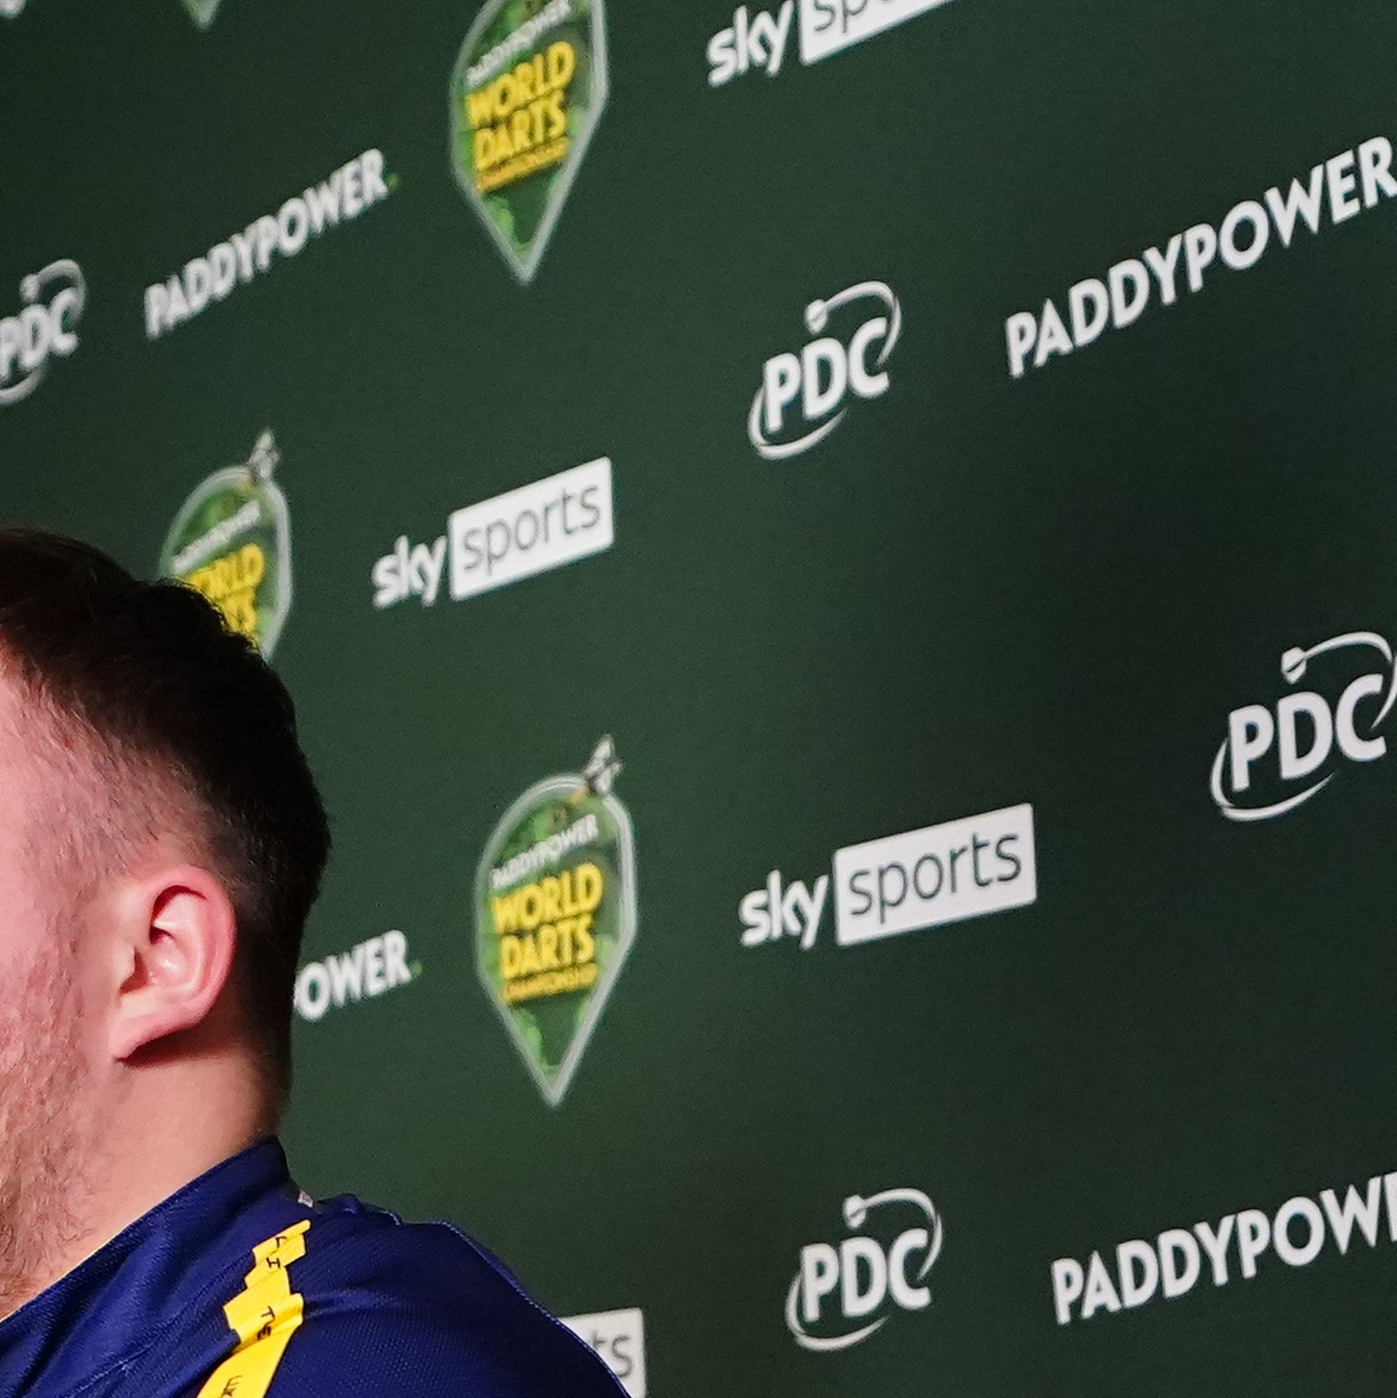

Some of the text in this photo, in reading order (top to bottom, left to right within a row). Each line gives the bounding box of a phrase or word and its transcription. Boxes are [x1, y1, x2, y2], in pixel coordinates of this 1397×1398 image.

[464, 41, 576, 127] WORLD
[708, 2, 790, 87] sky
[474, 89, 567, 172] DARTS
[764, 318, 889, 432] PDC
[190, 543, 265, 598] ORLD
[372, 483, 601, 609] sky sports
[1228, 674, 1388, 791] PDC
[491, 863, 604, 935] WORLD
[739, 831, 1023, 951] sky sports
[500, 912, 595, 980] DARTS
[801, 1228, 931, 1325] PDC
[1051, 1171, 1397, 1326] PADDYPOWE
